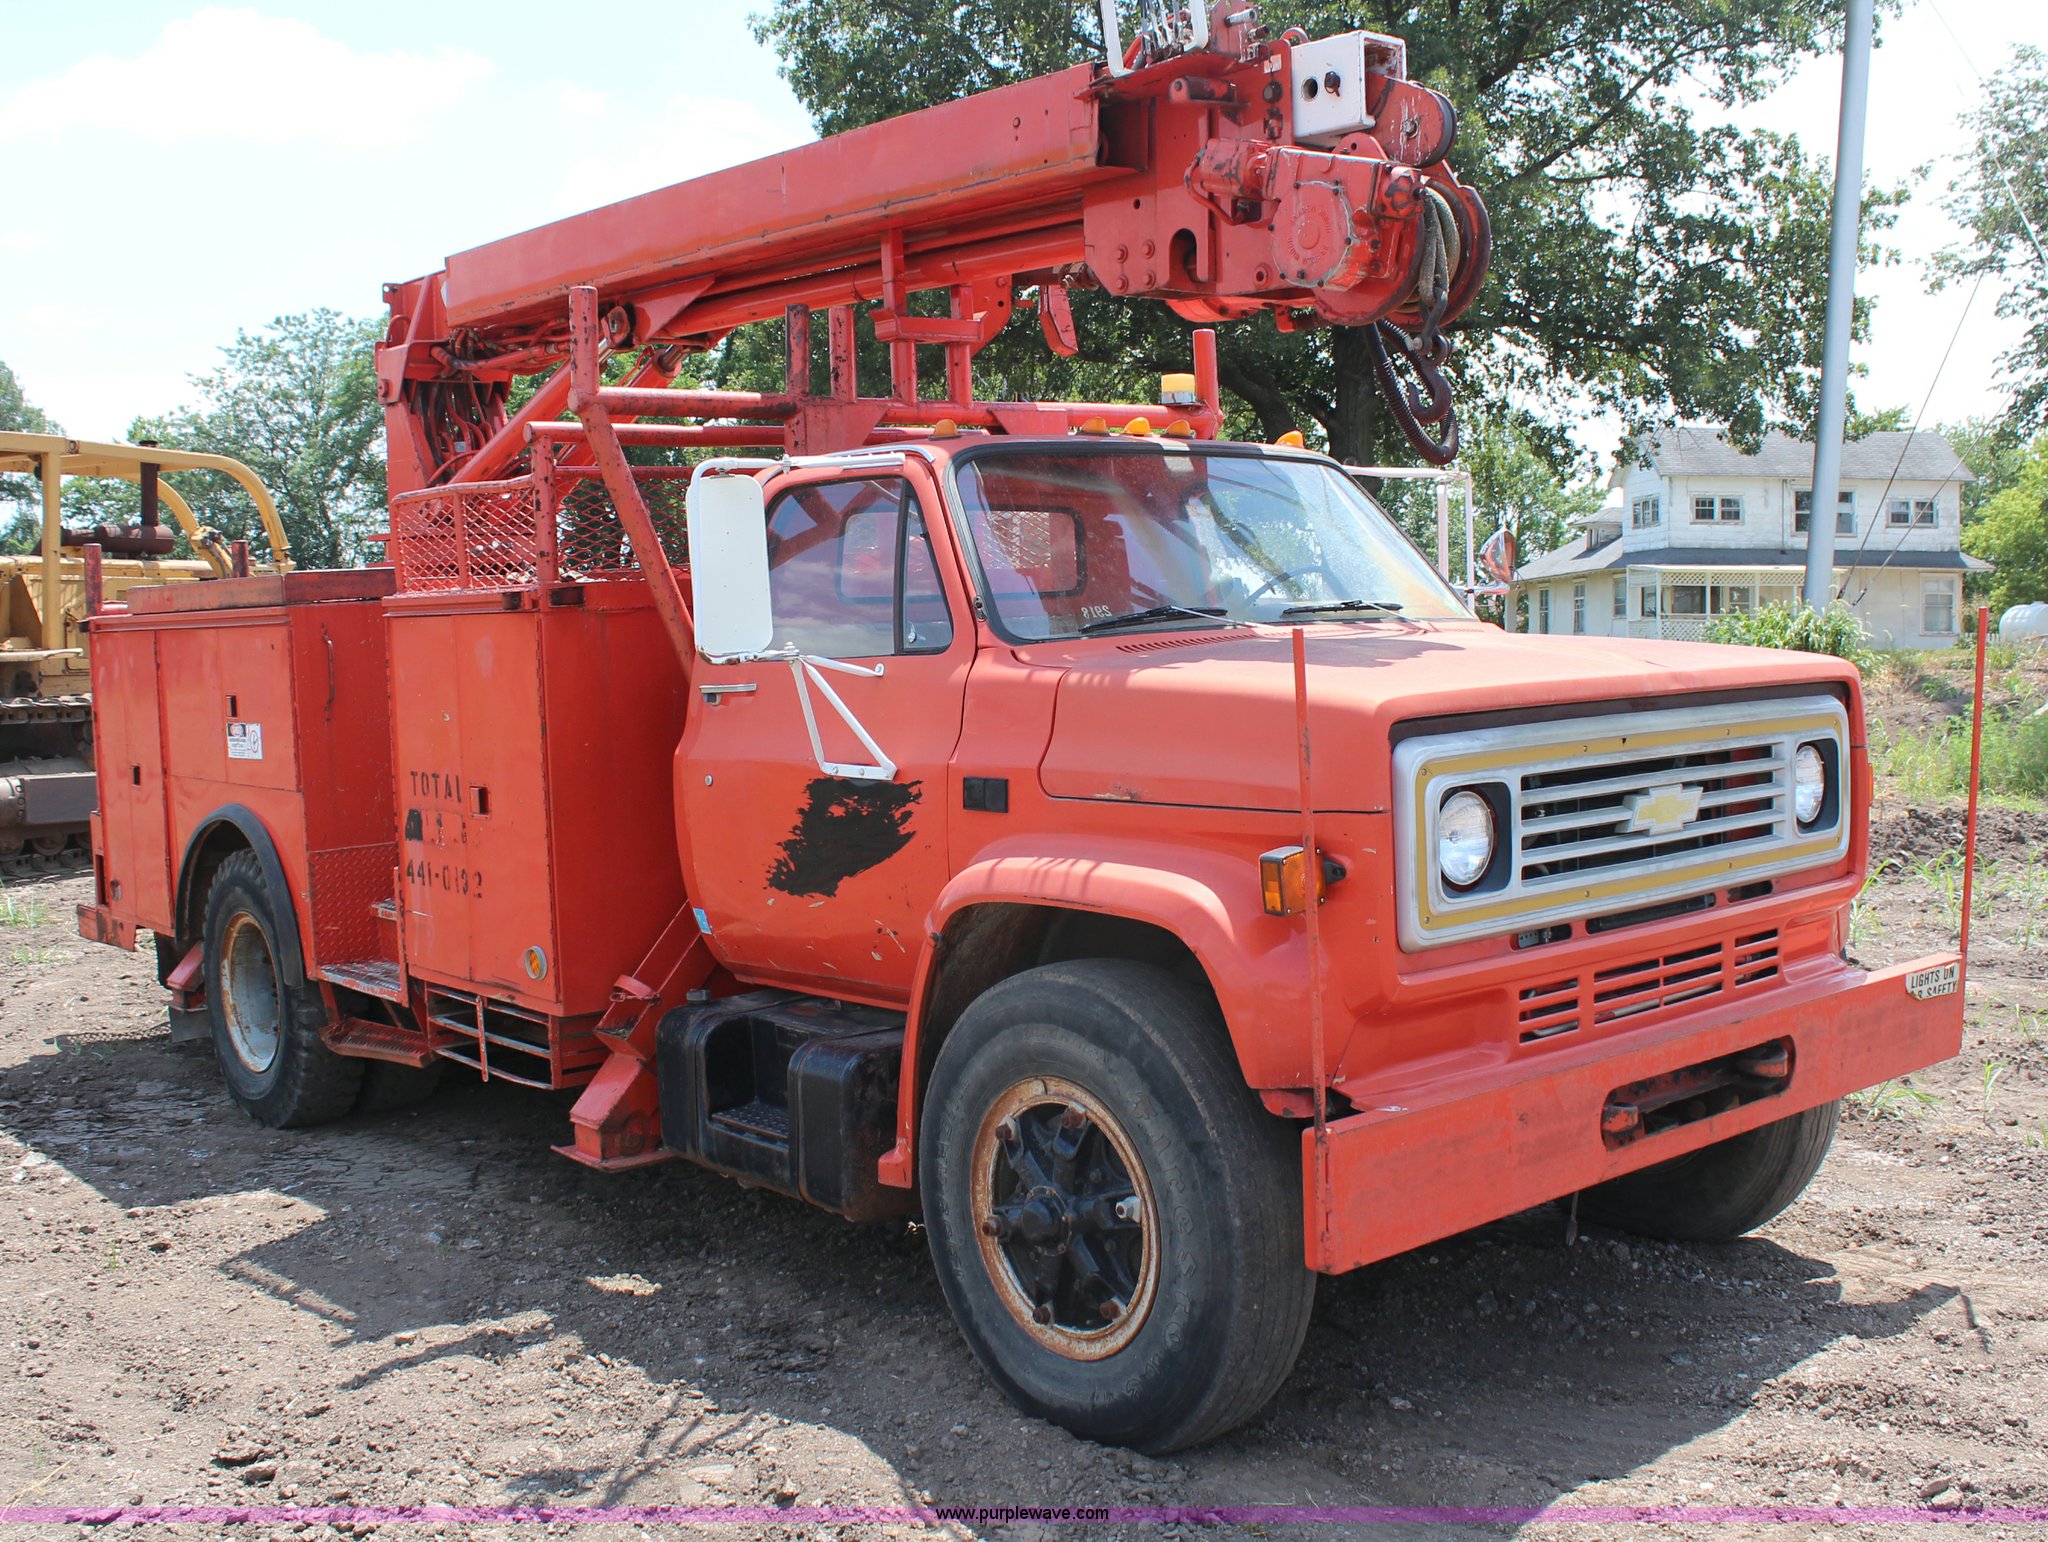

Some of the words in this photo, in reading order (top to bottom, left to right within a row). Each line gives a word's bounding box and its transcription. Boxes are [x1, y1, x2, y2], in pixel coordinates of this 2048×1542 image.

[410, 770, 463, 803] TOTAL
[1911, 969, 1940, 989] LIGHTS
[1943, 965, 1955, 980] ON
